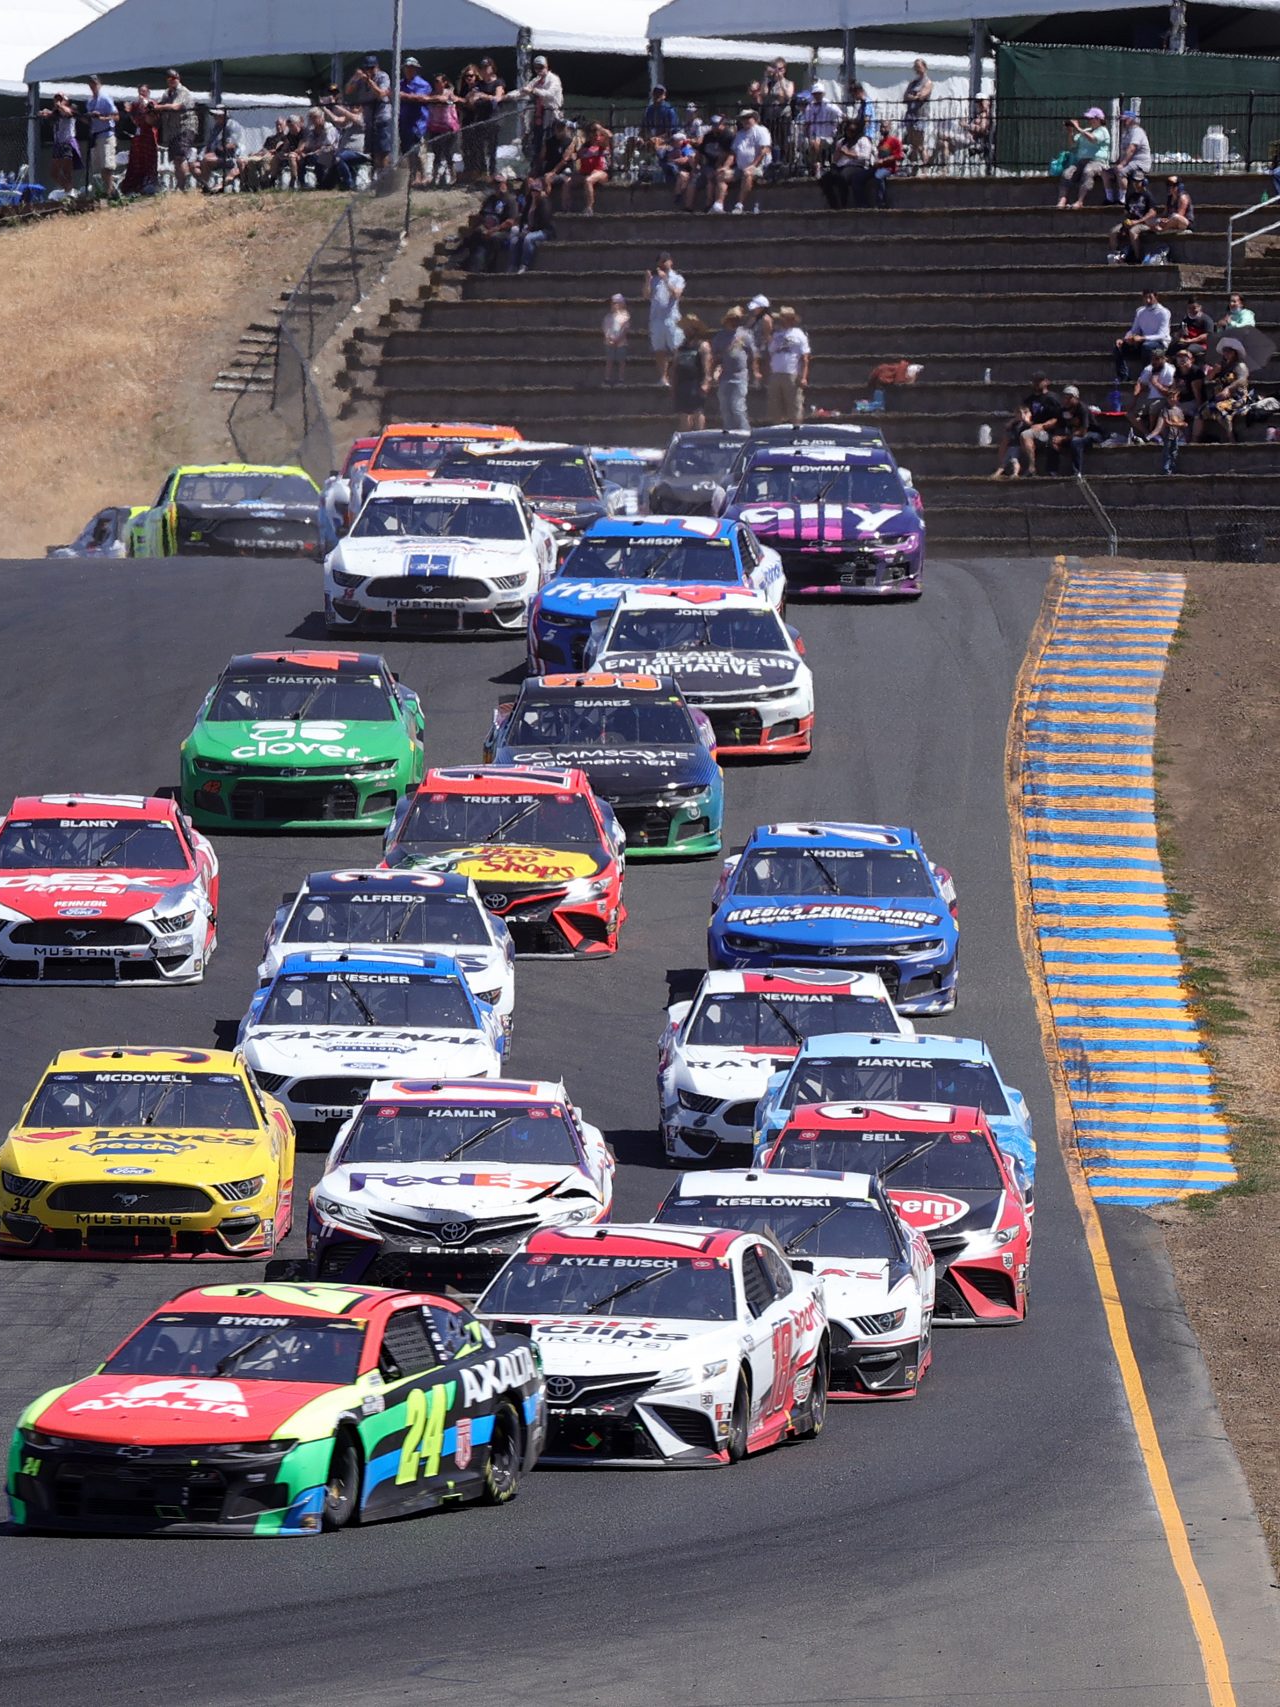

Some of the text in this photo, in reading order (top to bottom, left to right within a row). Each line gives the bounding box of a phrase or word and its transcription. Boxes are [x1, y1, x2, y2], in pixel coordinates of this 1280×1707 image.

[487, 459, 542, 467] REDDICK
[792, 465, 850, 473] BOWMAN
[739, 503, 903, 540] ally
[629, 537, 683, 546] LARSON
[386, 600, 466, 609] MUSTANG
[675, 609, 719, 617] JONES
[542, 629, 557, 641] 5
[637, 663, 762, 677] INITIATIVE
[267, 676, 337, 685] CHASTAIN
[574, 699, 631, 708] SUAREZ
[231, 741, 361, 759] clover
[462, 795, 511, 804] TRUEX
[60, 819, 119, 828] BLANEY
[803, 849, 864, 858] RHODES
[478, 860, 576, 879] Shops
[53, 899, 108, 908] PENNZOIL
[351, 894, 426, 903] ALFREDO
[809, 905, 938, 924] PERFORMANCE
[34, 947, 124, 956] MUSTANG
[733, 957, 751, 968] 77
[326, 973, 411, 984] BUESCHER
[760, 993, 833, 1003] NEWMAN
[857, 1058, 933, 1069] HARVICK
[95, 1073, 193, 1083] MCDOWELL
[428, 1108, 497, 1118] HAMLIN
[862, 1132, 906, 1142] BELL
[349, 1172, 561, 1192] FedEx
[10, 1197, 31, 1214] 34
[716, 1197, 831, 1207] KESELOWSKI
[76, 1213, 183, 1226] MUSTANG
[409, 1246, 497, 1255] CAMRY
[560, 1257, 678, 1269] KYLE BUSCH
[218, 1316, 290, 1327] BYRON
[537, 1325, 691, 1342] Clips
[766, 1317, 793, 1416] 18
[459, 1347, 537, 1408] AXALTA
[701, 1393, 713, 1405] 30
[67, 1397, 250, 1417] AXALTA
[395, 1383, 446, 1485] 24
[22, 1457, 42, 1477] 24
